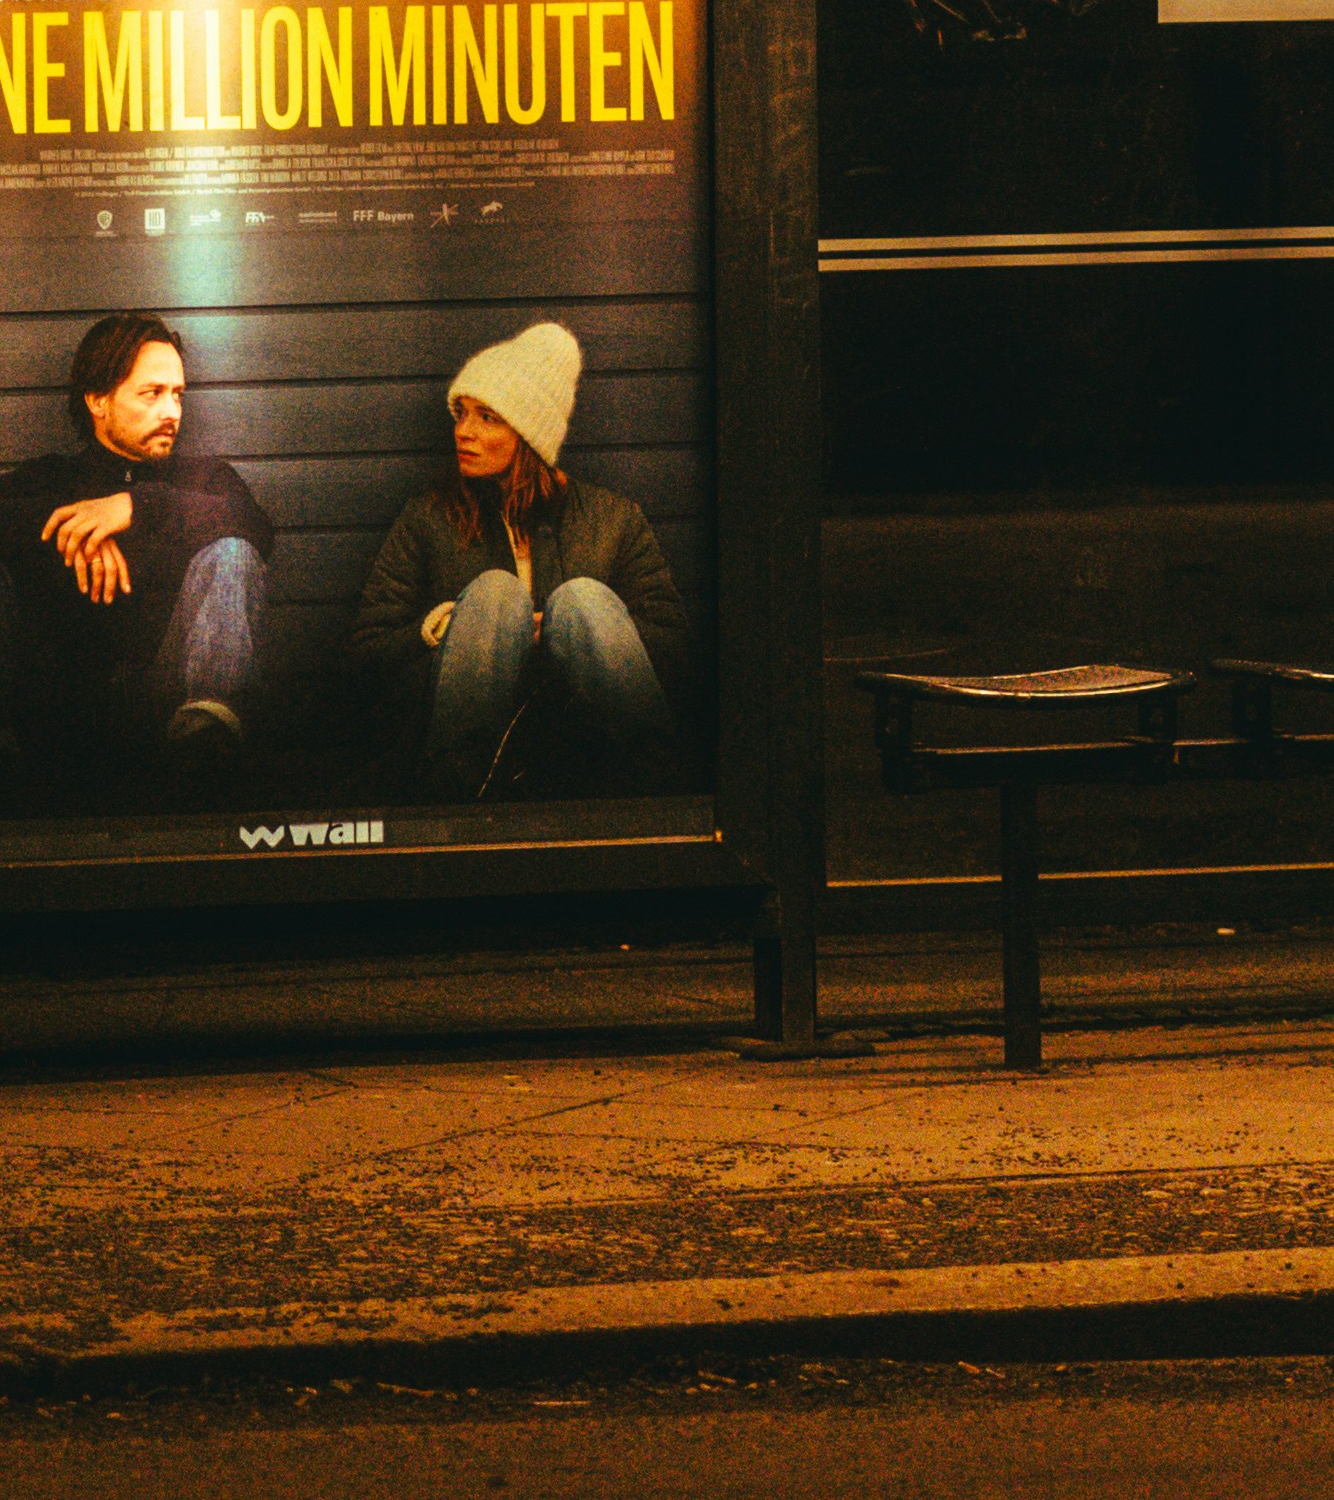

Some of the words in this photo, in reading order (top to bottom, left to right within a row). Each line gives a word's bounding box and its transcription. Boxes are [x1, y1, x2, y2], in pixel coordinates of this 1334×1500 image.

[83, 5, 354, 133] MILLION
[368, 0, 675, 127] MINUTEN
[352, 209, 374, 222] FFF
[377, 209, 415, 224] Bayern
[288, 820, 384, 846] Wall
